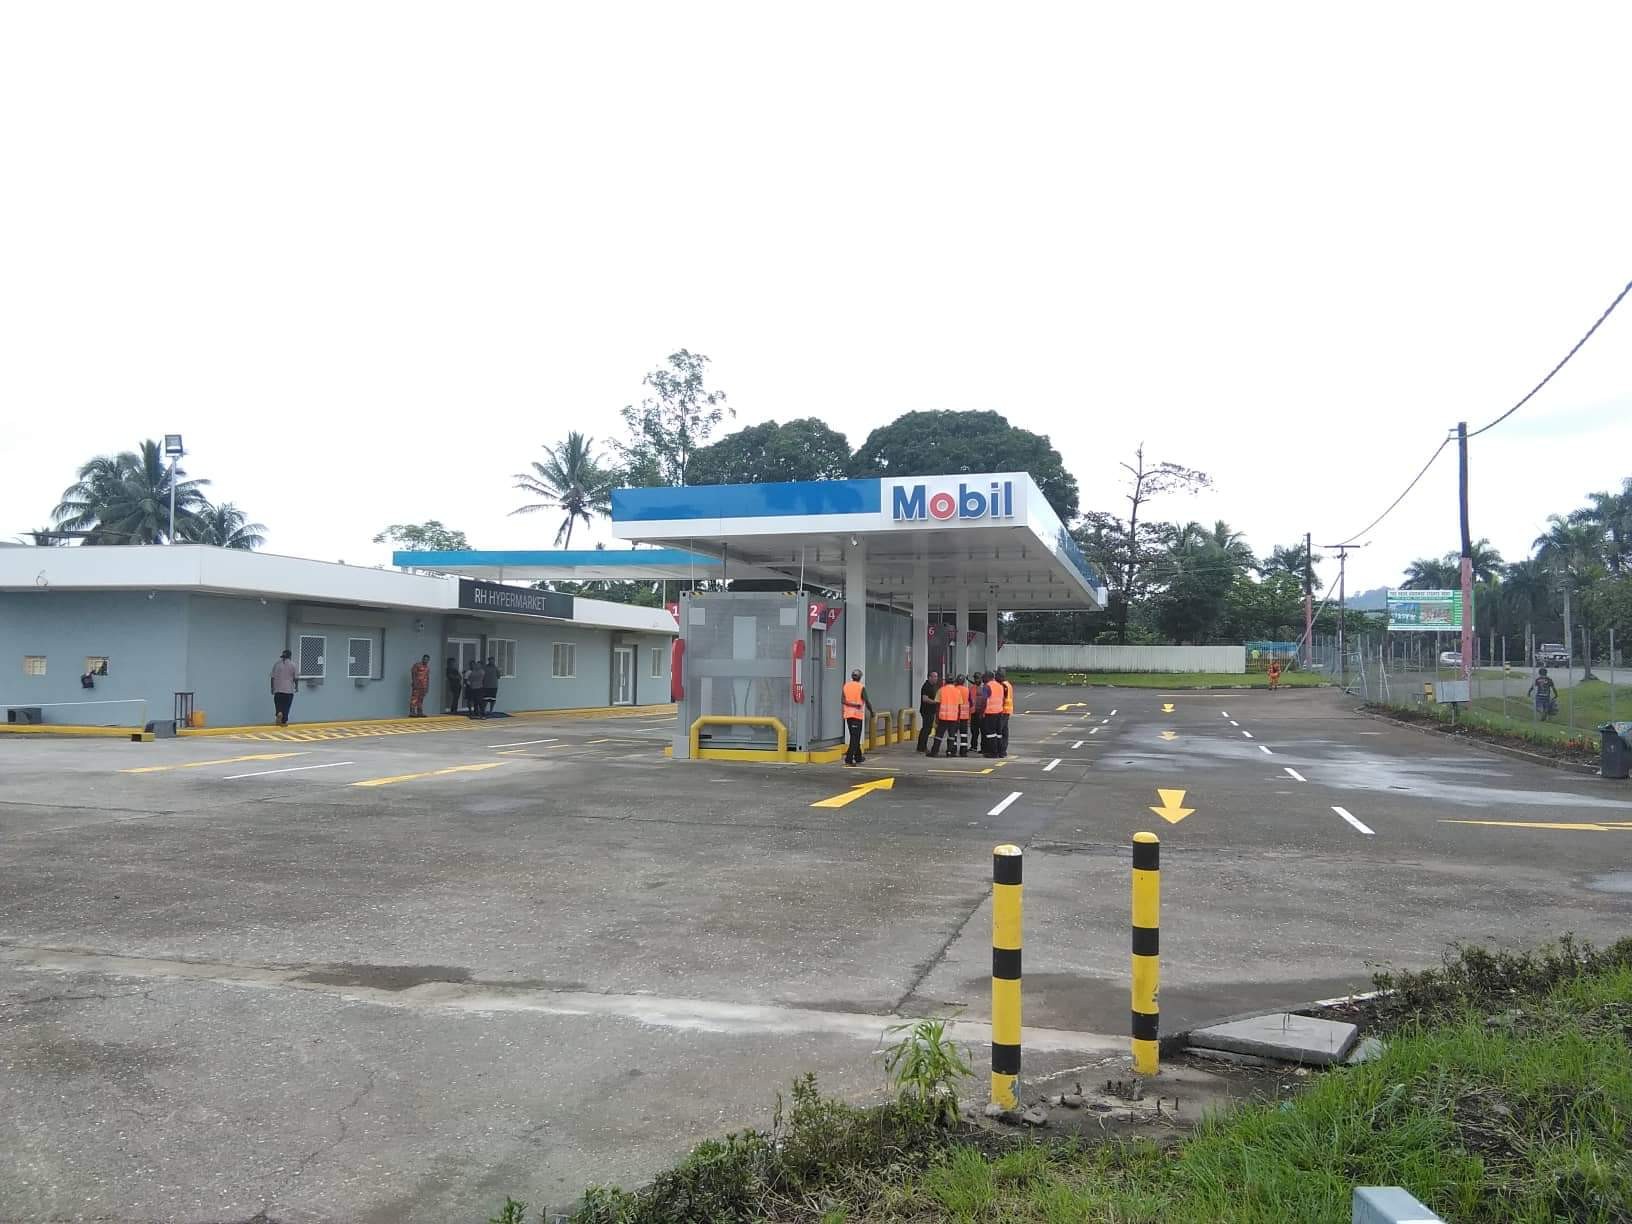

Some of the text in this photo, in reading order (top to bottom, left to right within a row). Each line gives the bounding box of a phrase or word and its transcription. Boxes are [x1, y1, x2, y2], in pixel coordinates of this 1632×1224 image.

[892, 481, 1013, 520] Mobil
[474, 588, 546, 611] RH HYPERMARKET
[672, 605, 679, 617] 1
[810, 605, 818, 617] 2
[828, 609, 836, 620] 4
[928, 626, 935, 636] 6
